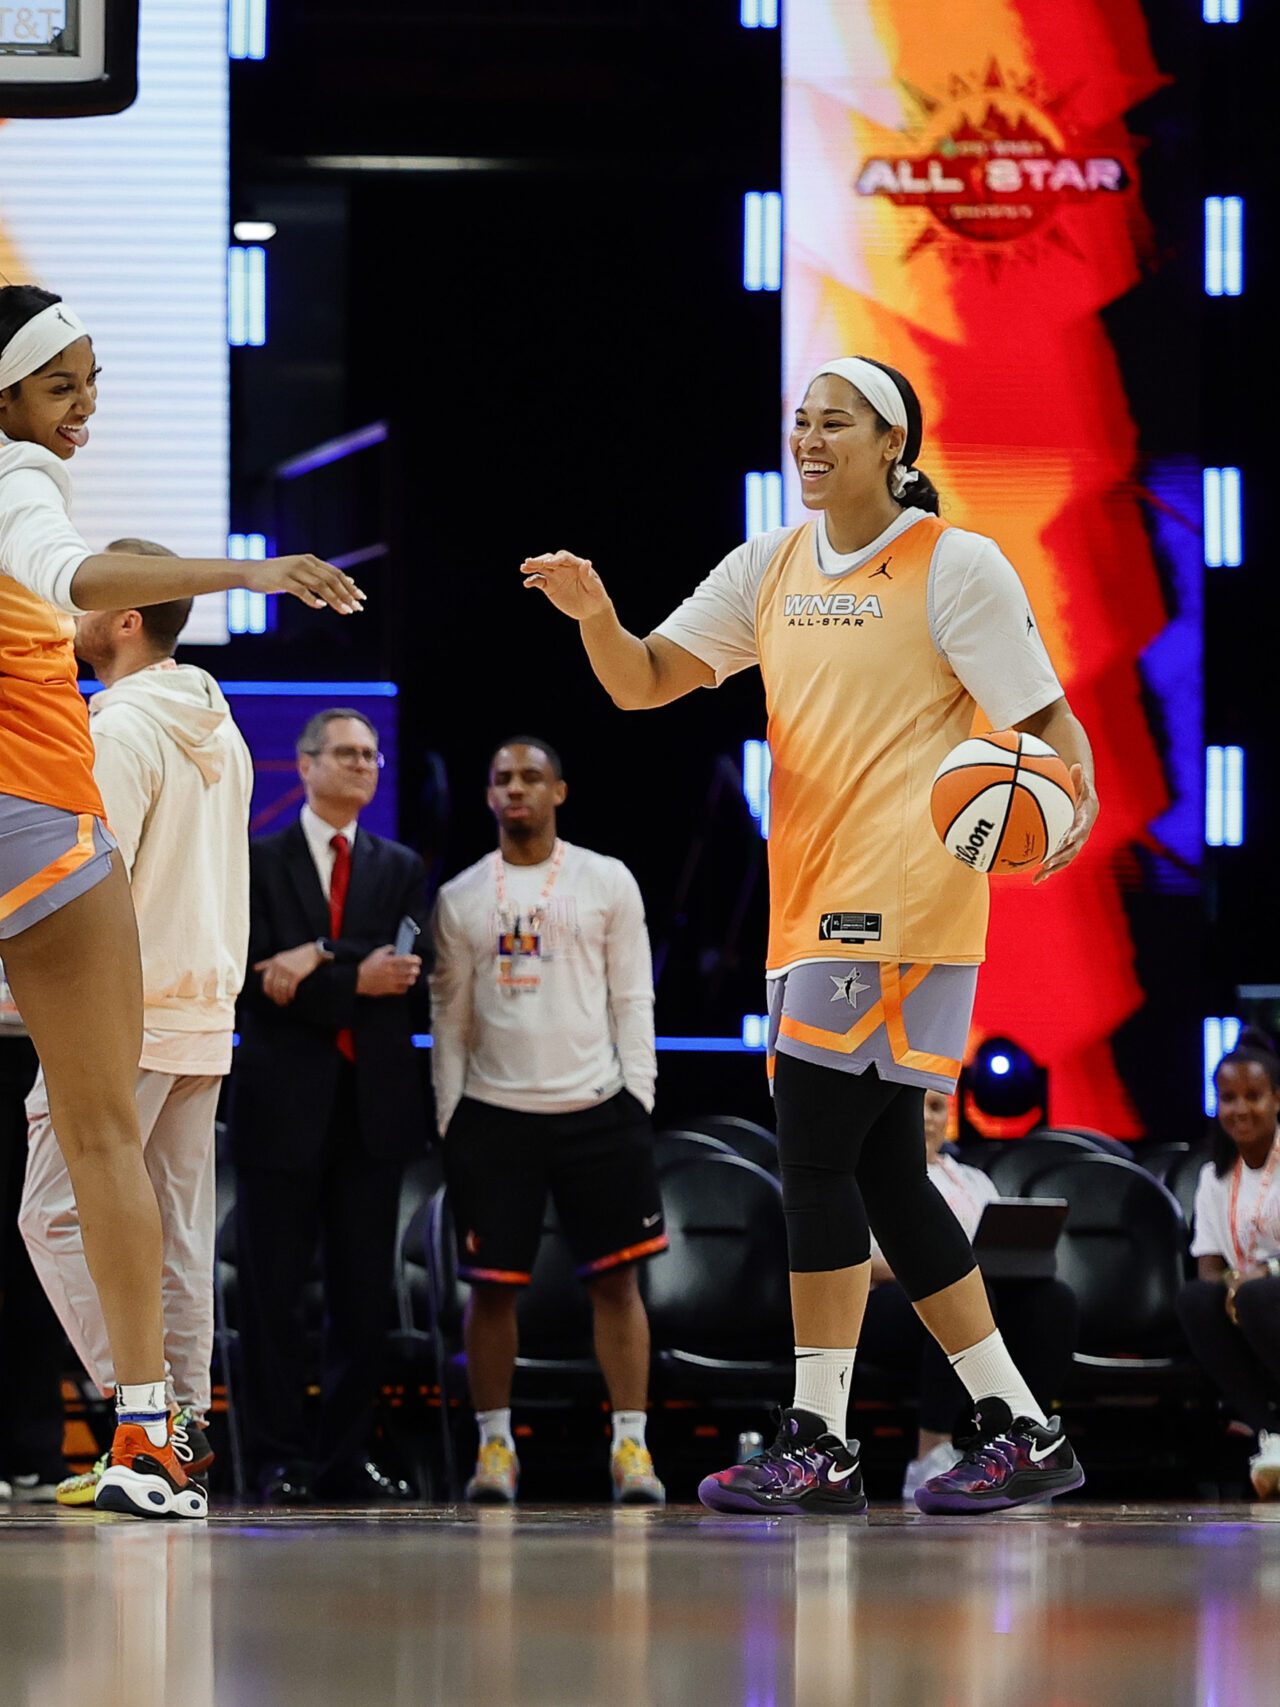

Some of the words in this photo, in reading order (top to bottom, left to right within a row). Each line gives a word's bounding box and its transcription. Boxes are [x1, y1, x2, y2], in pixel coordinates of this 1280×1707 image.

[857, 160, 965, 195] ALL
[985, 158, 1122, 193] STAR
[784, 594, 883, 618] WNBA
[788, 618, 864, 627] ALL-STAR
